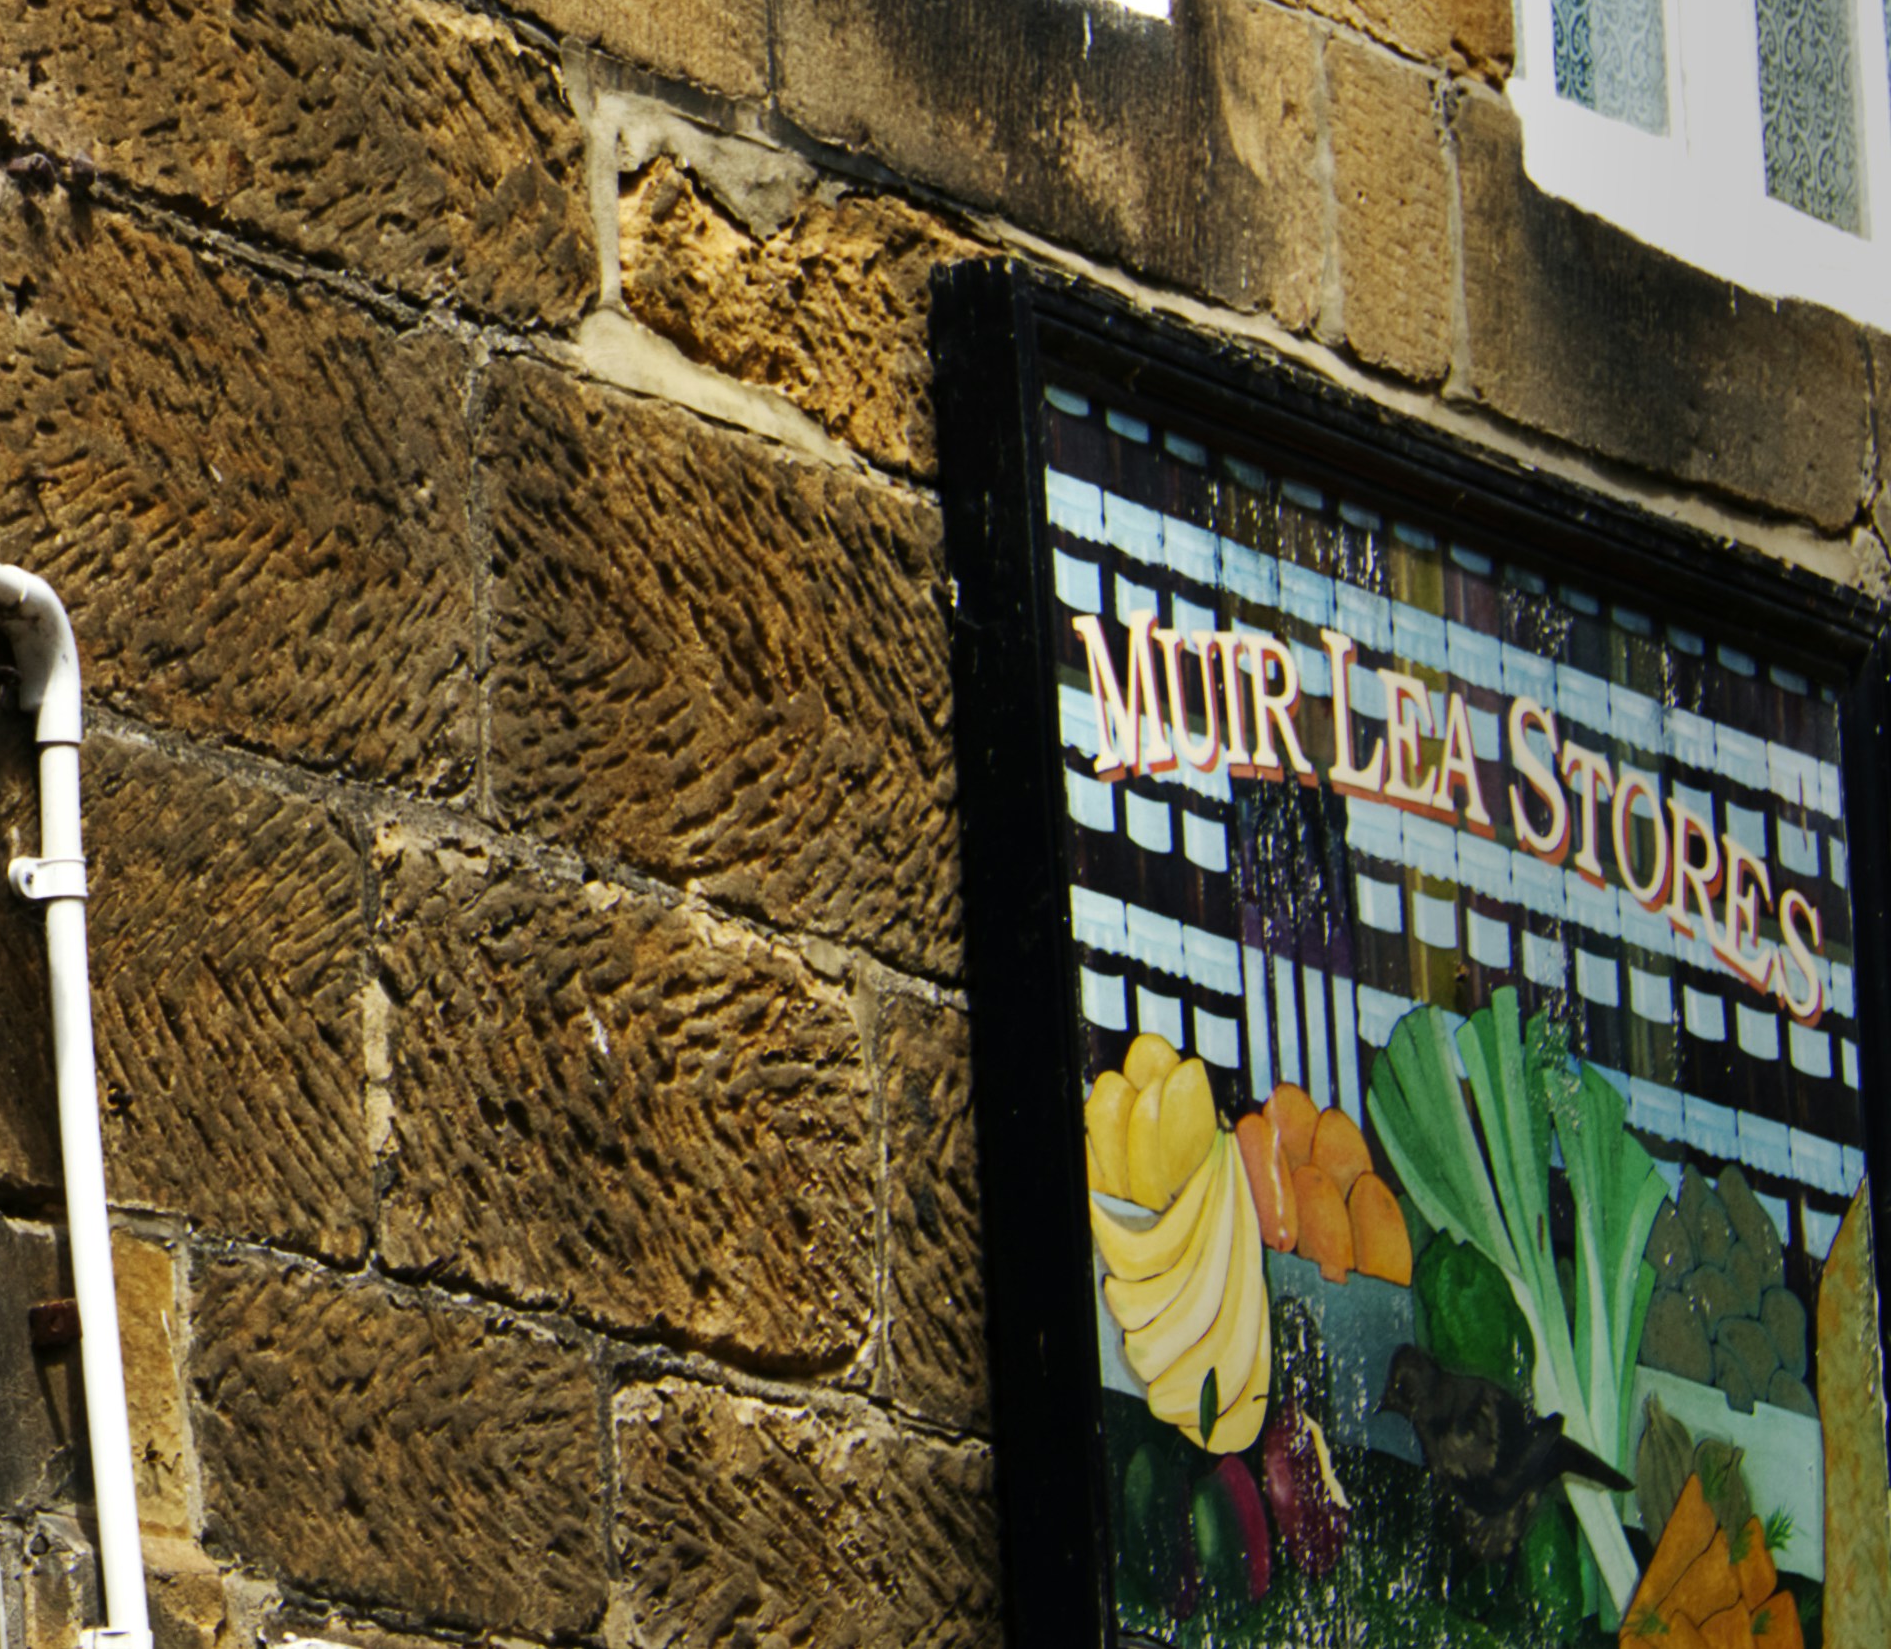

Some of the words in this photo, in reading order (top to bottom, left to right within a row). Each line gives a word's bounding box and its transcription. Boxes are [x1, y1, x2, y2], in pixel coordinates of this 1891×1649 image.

[1073, 610, 1317, 787] MUIR
[1321, 630, 1495, 837] LEA
[1508, 697, 1824, 1026] STORES
